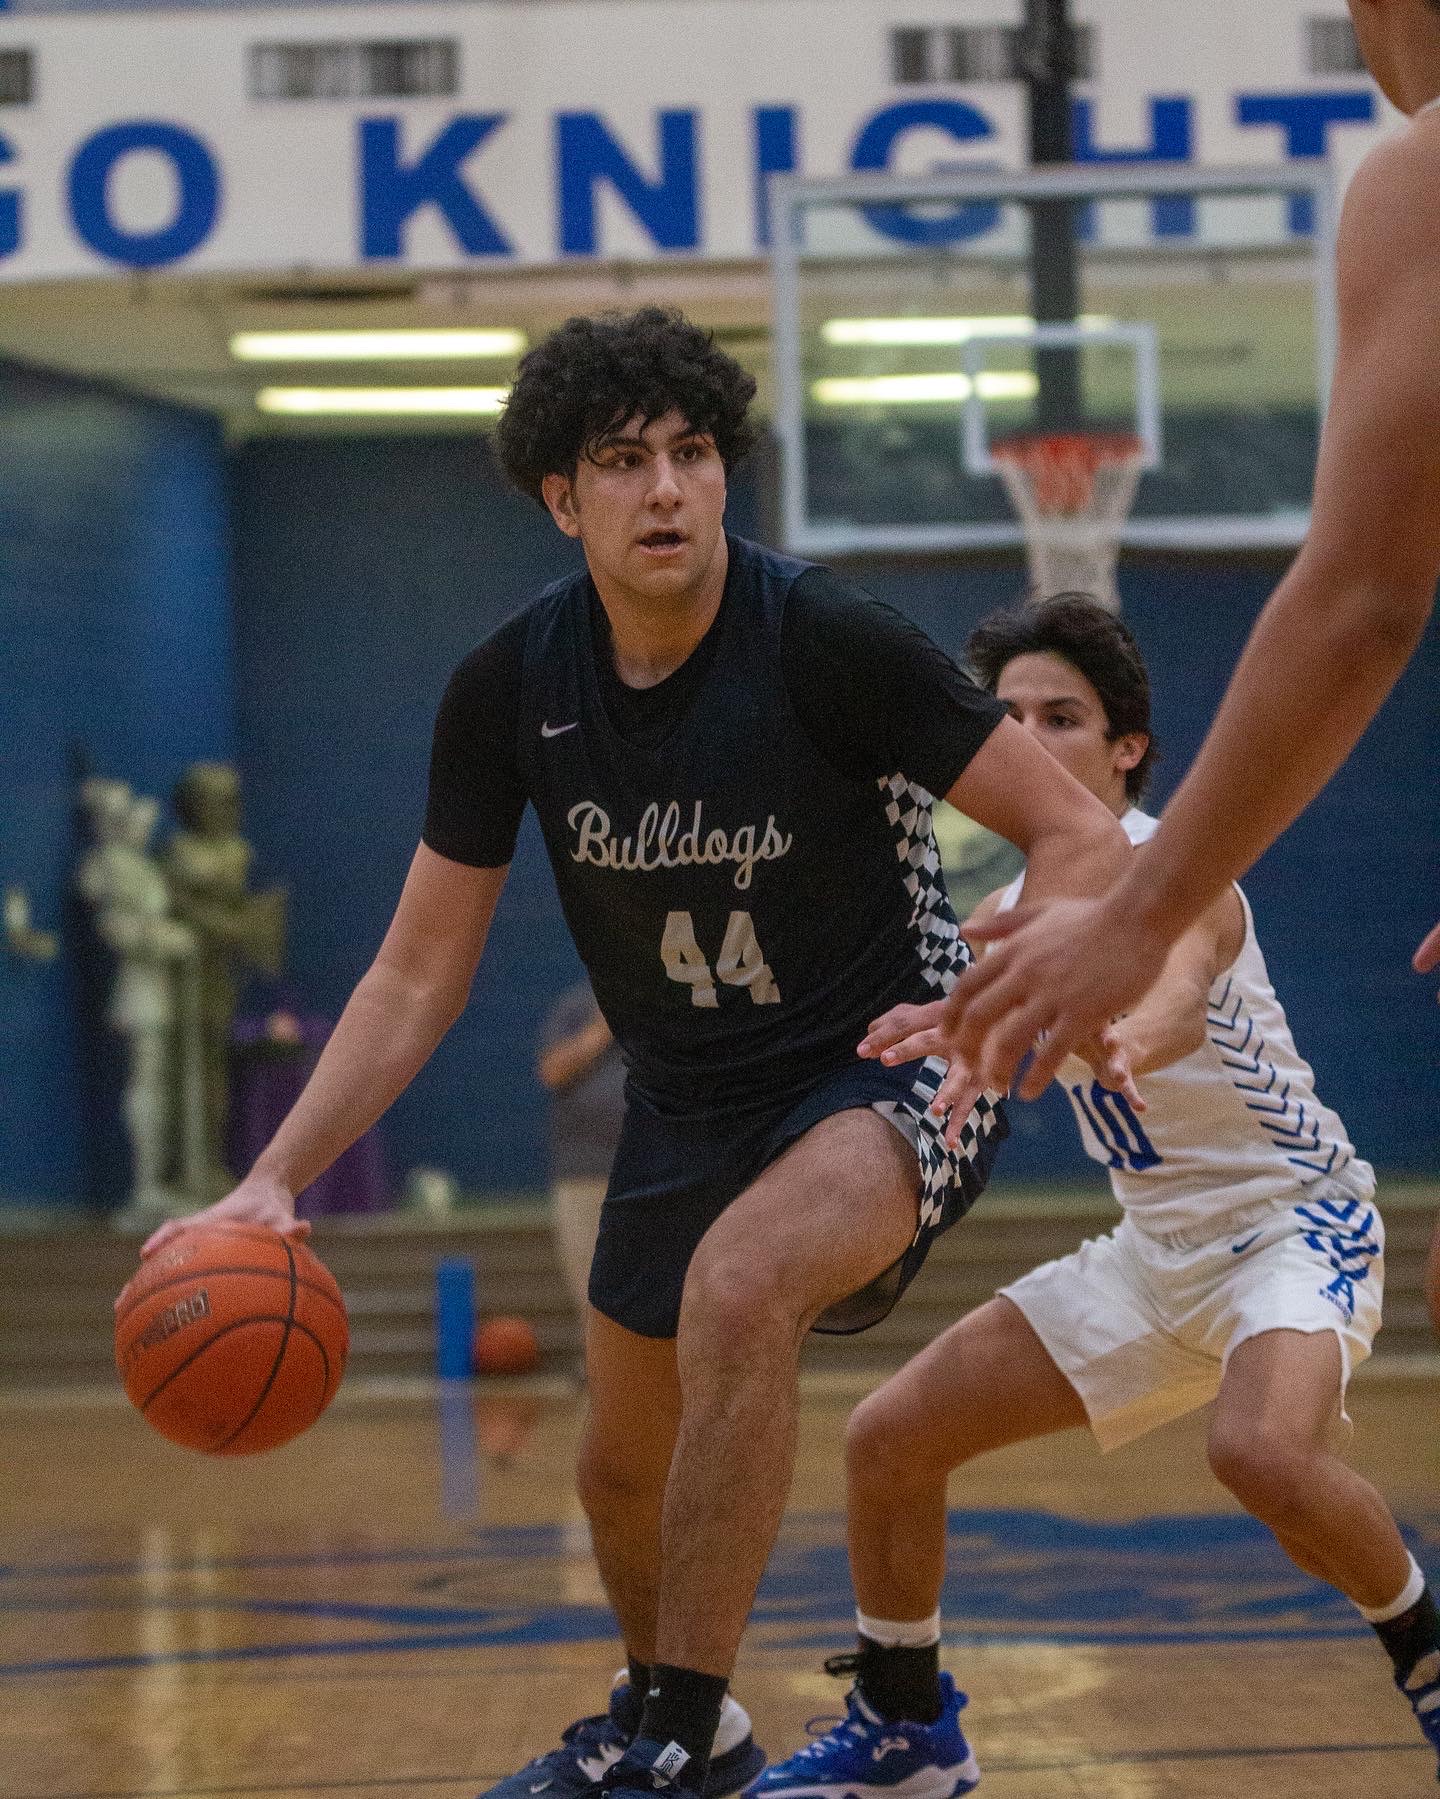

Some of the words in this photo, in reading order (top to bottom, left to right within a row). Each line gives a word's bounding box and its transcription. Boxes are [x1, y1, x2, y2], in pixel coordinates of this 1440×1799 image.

[0, 119, 223, 270] O
[566, 800, 793, 890] Bulldogs
[660, 911, 782, 1008] 44
[1071, 1078, 1163, 1172] 10
